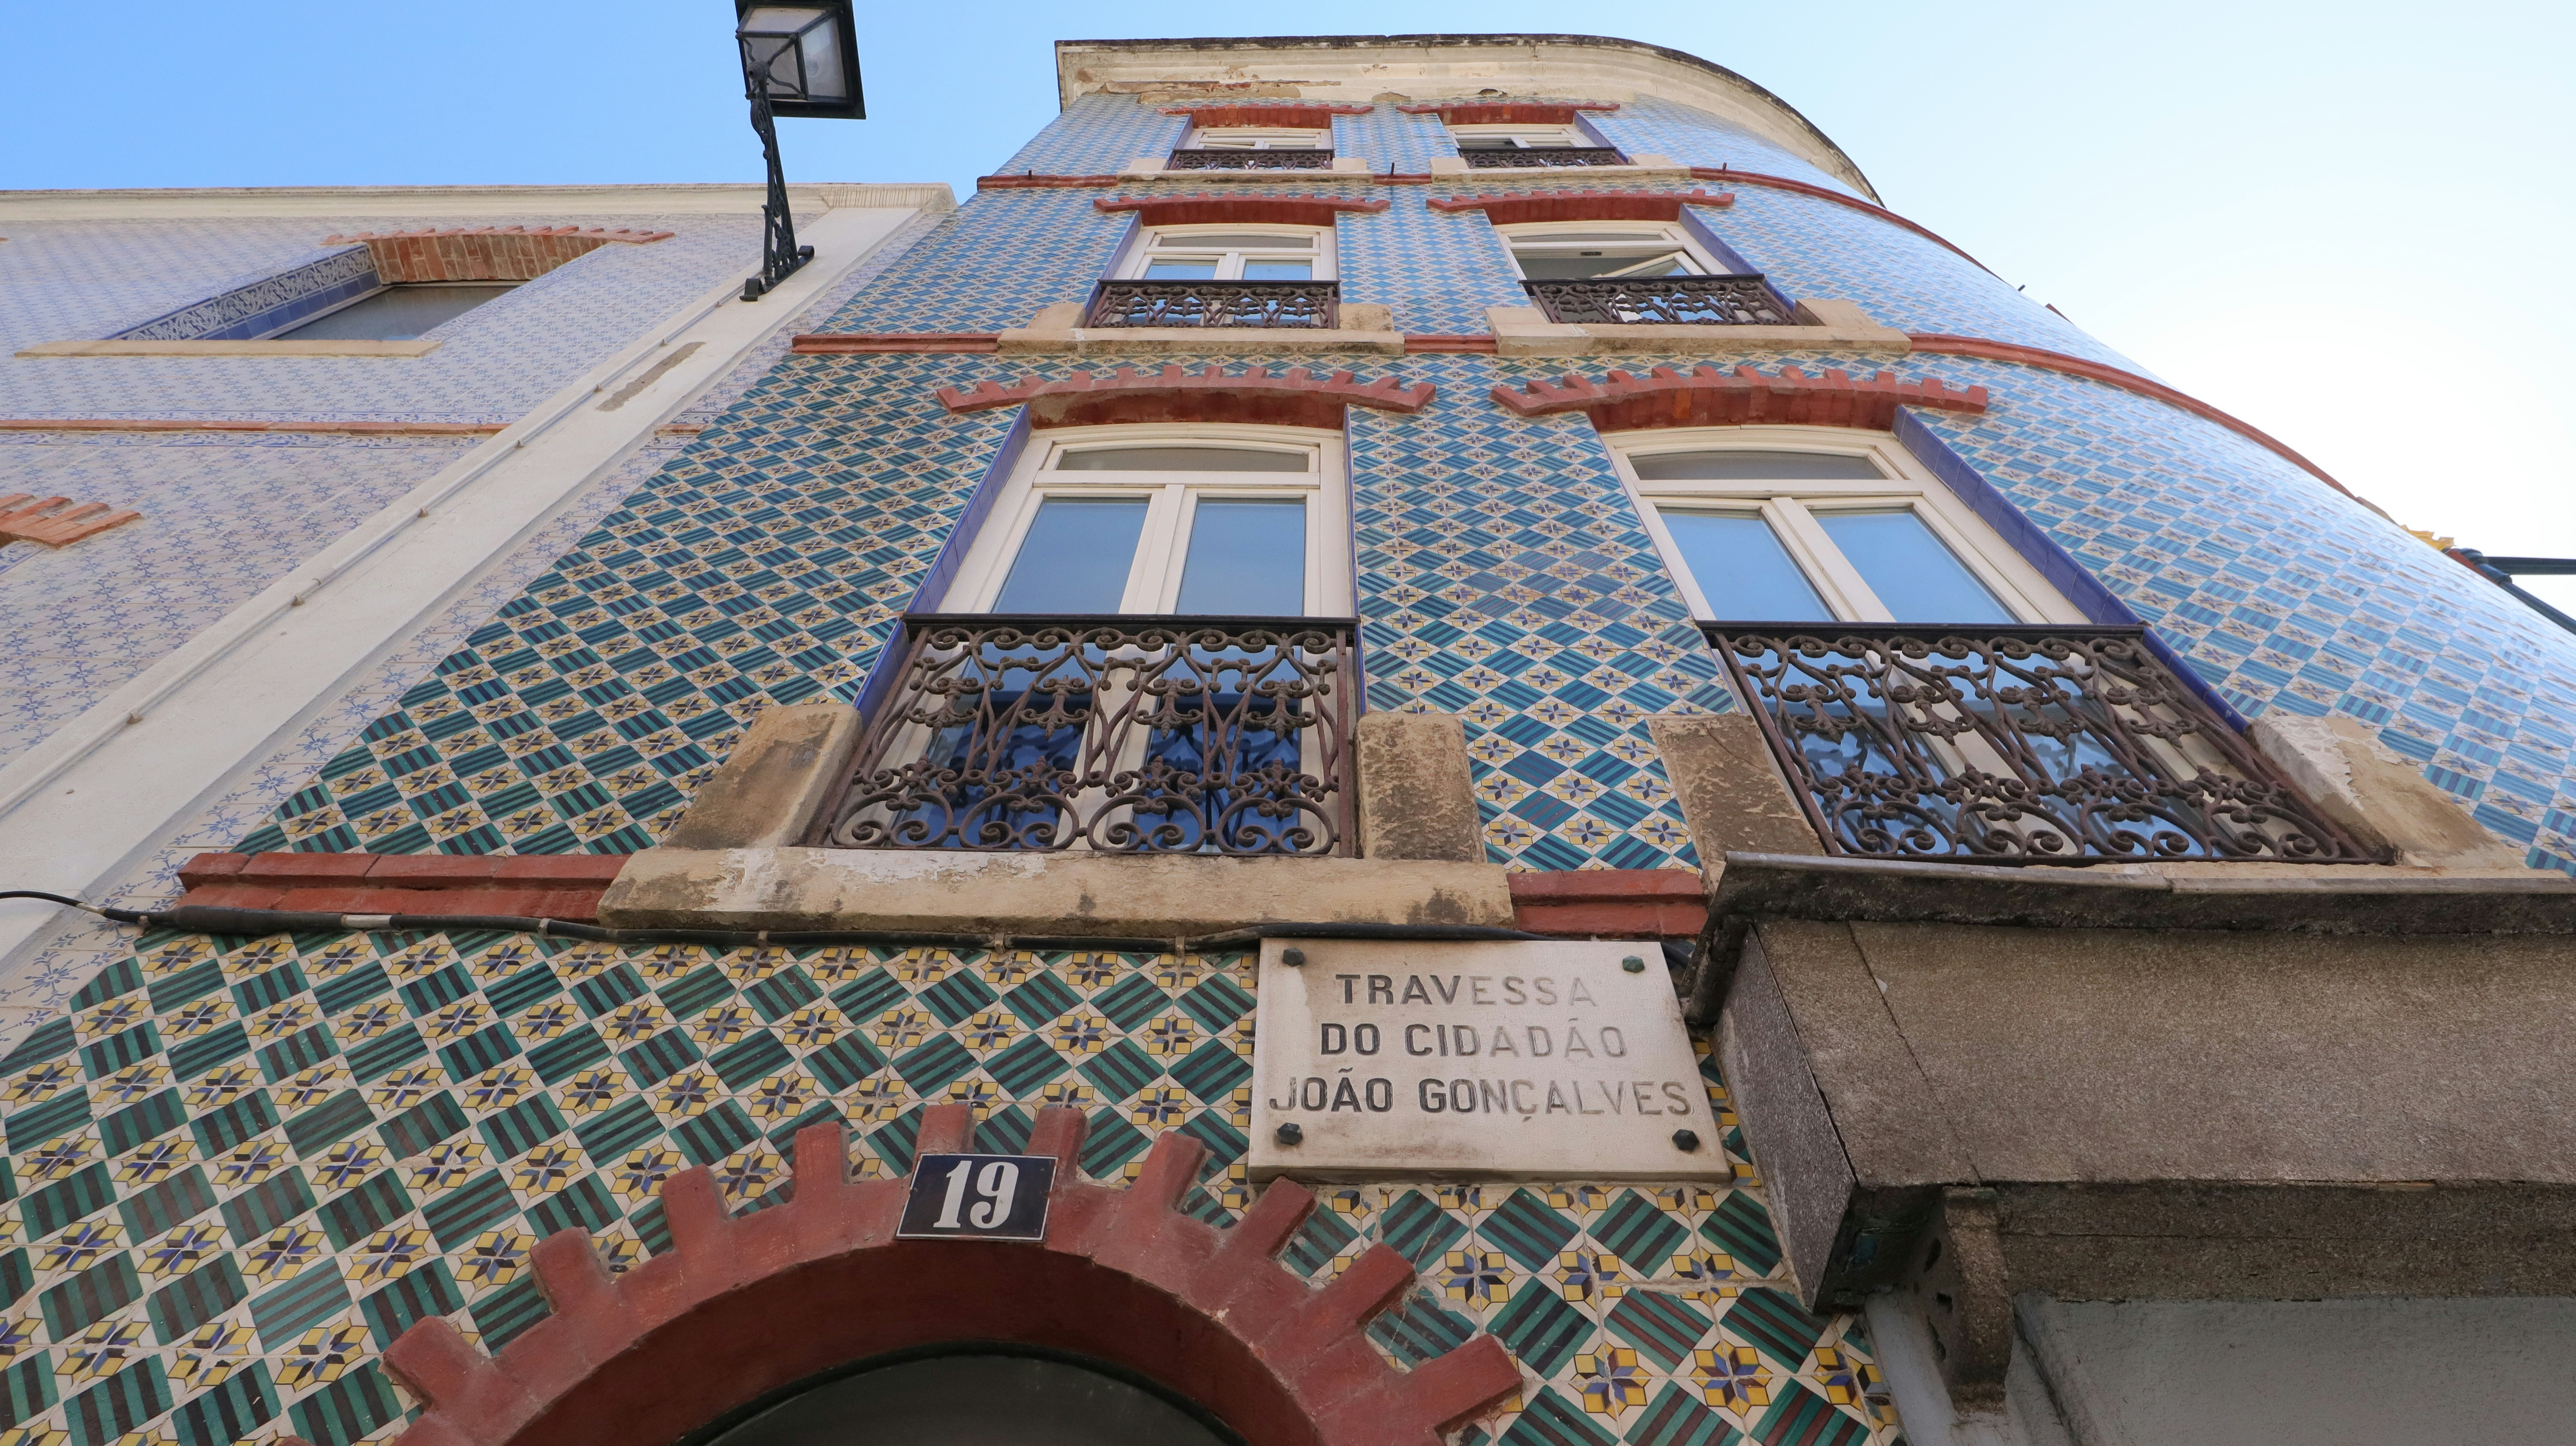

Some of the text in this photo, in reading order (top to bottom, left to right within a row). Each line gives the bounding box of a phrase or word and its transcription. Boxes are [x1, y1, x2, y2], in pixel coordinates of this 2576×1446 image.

[1336, 974, 1598, 1007] TRAVESSA
[1321, 1018, 1626, 1058] DO CIDADÃO
[1269, 1067, 1693, 1123] JOÃO GONÇALVES
[933, 1160, 1019, 1228] 19
